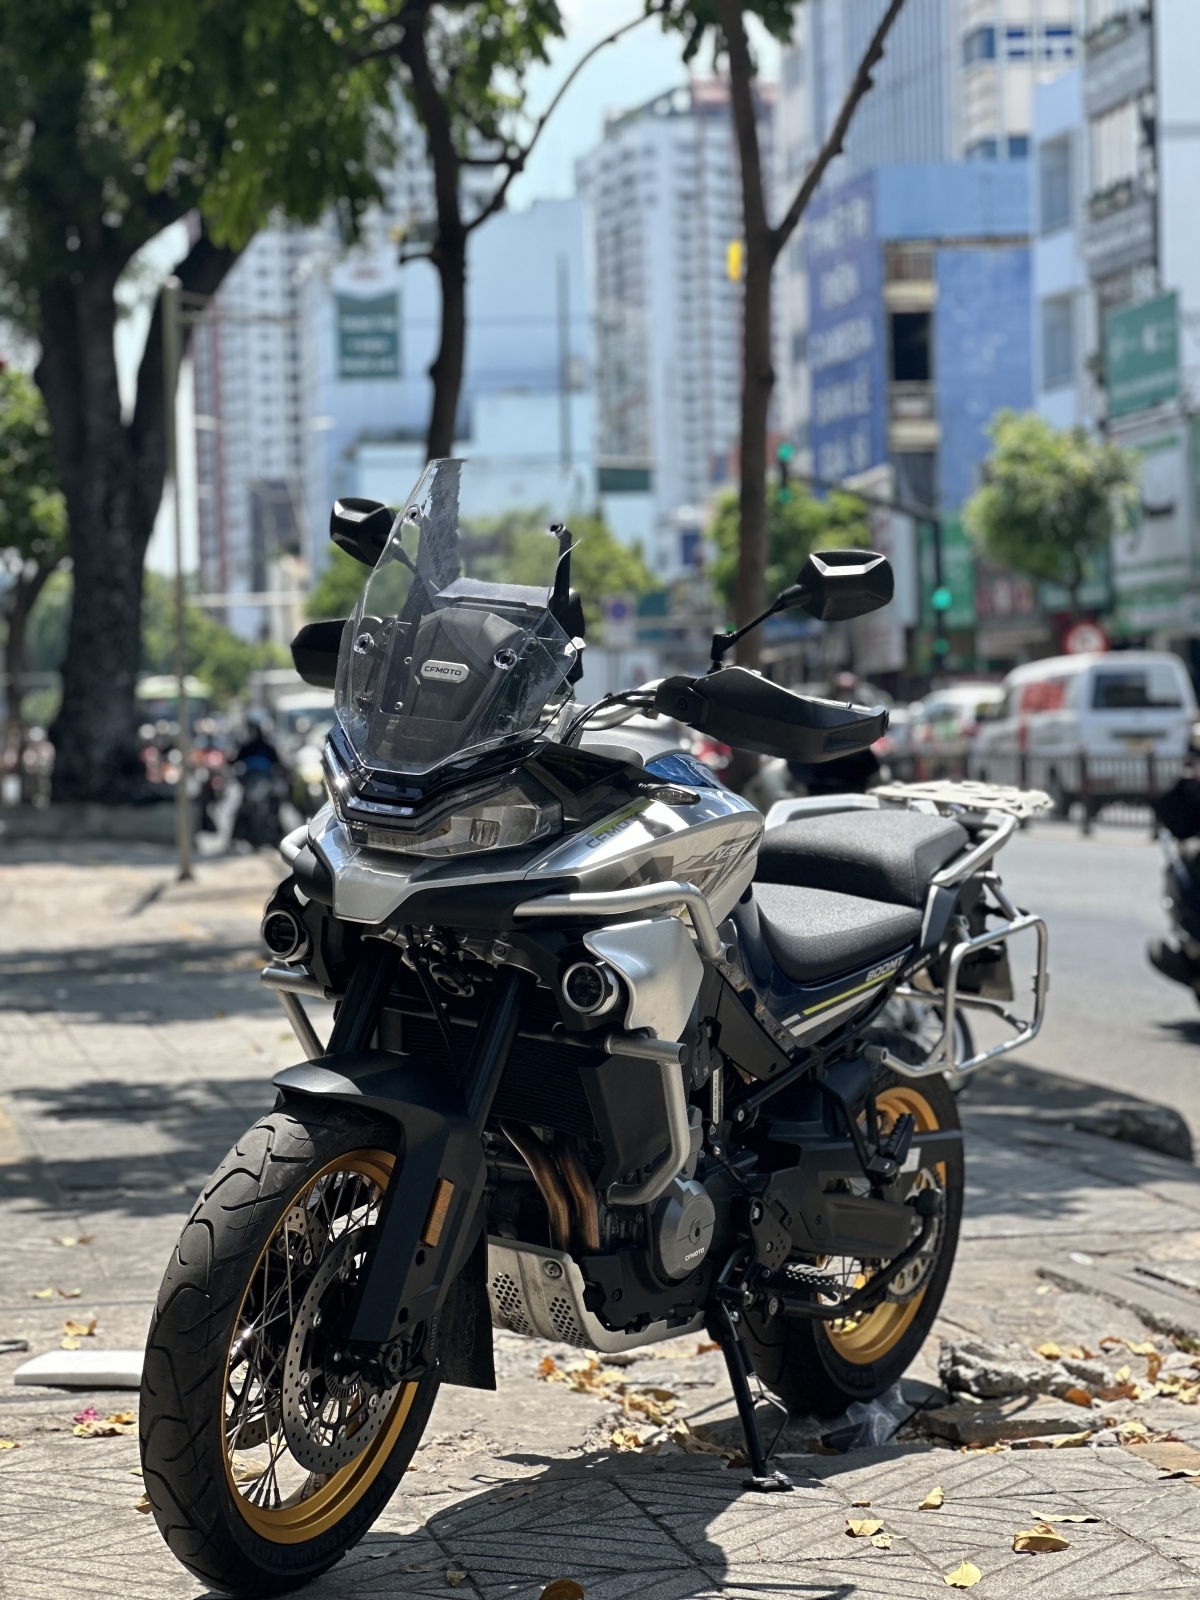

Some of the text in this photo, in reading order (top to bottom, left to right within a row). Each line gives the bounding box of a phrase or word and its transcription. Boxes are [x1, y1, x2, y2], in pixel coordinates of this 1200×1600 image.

[424, 665, 462, 676] CFMOTO
[866, 954, 905, 982] 800MT
[684, 1247, 705, 1262] CFMOTO
